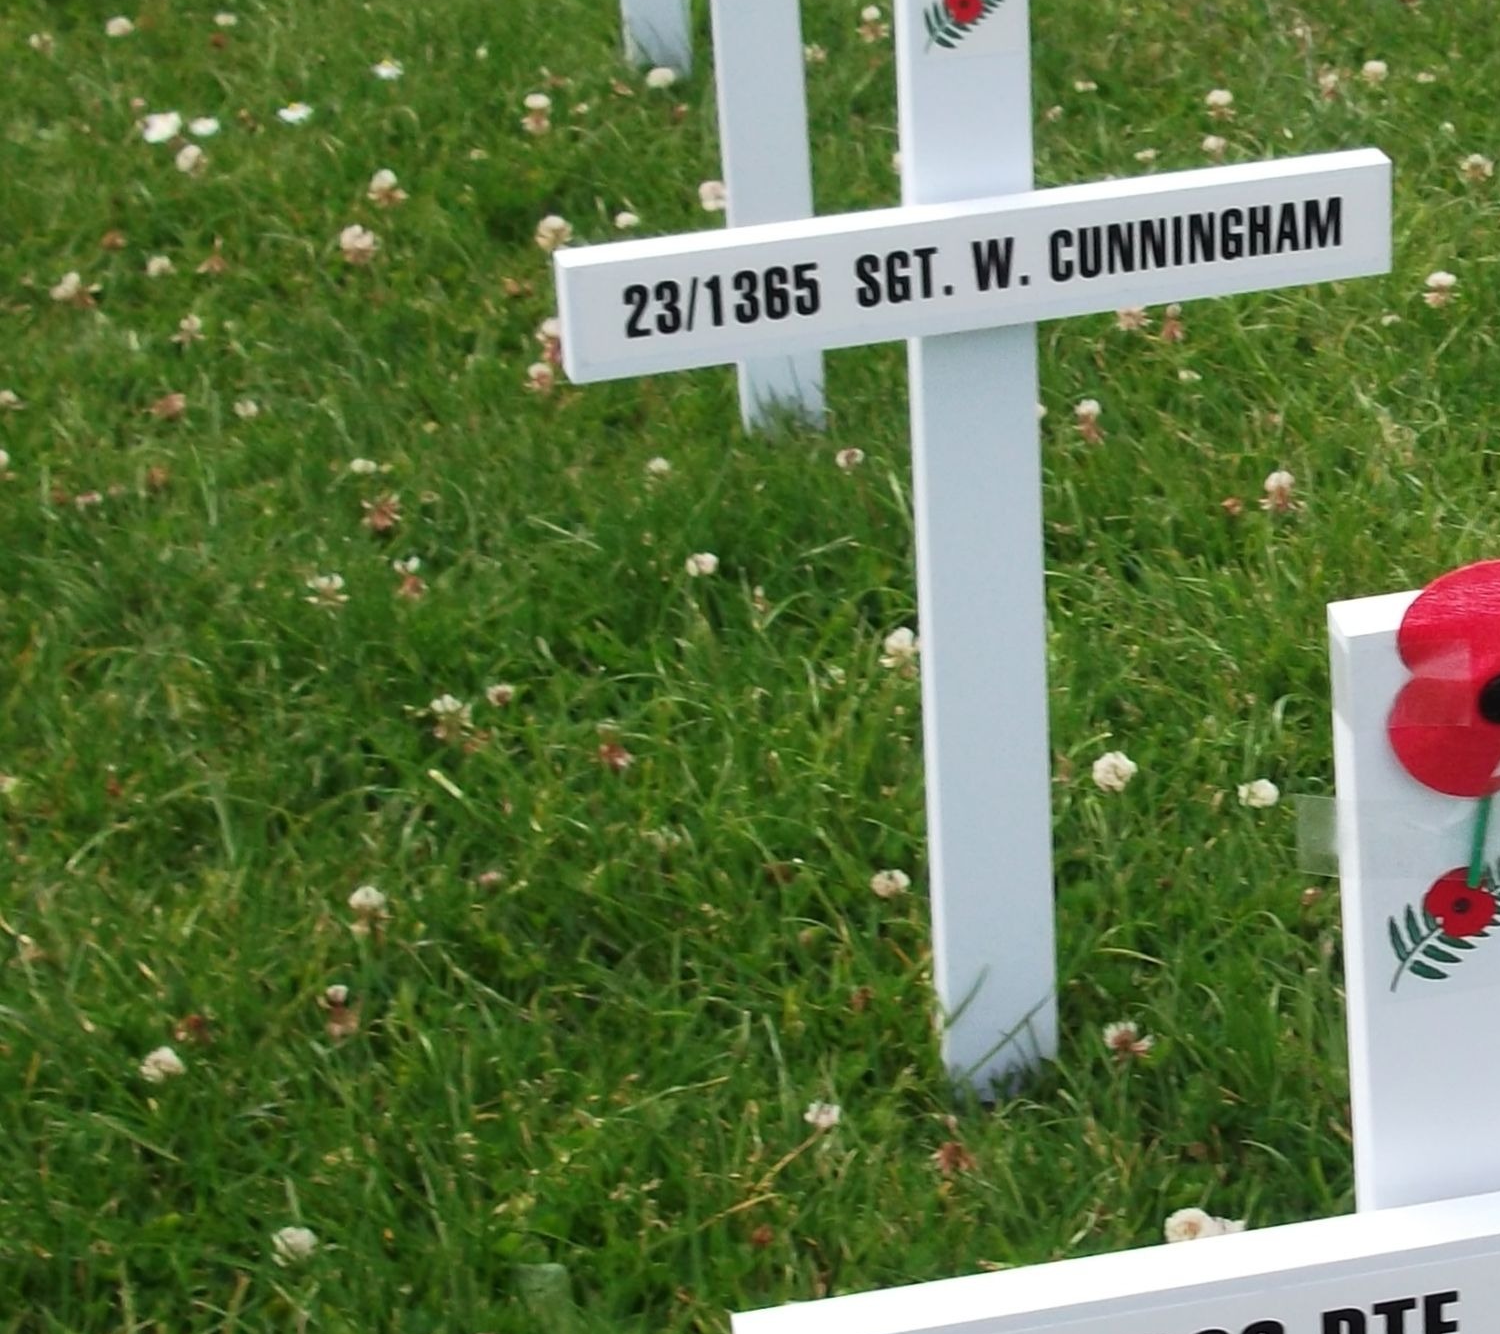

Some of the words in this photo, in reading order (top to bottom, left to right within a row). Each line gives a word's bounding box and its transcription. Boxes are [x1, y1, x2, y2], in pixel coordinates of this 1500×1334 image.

[624, 263, 820, 338] 23/1365
[856, 247, 952, 307] SGT.
[972, 237, 1029, 291] W.
[1050, 197, 1341, 283] CUNNINGHAM
